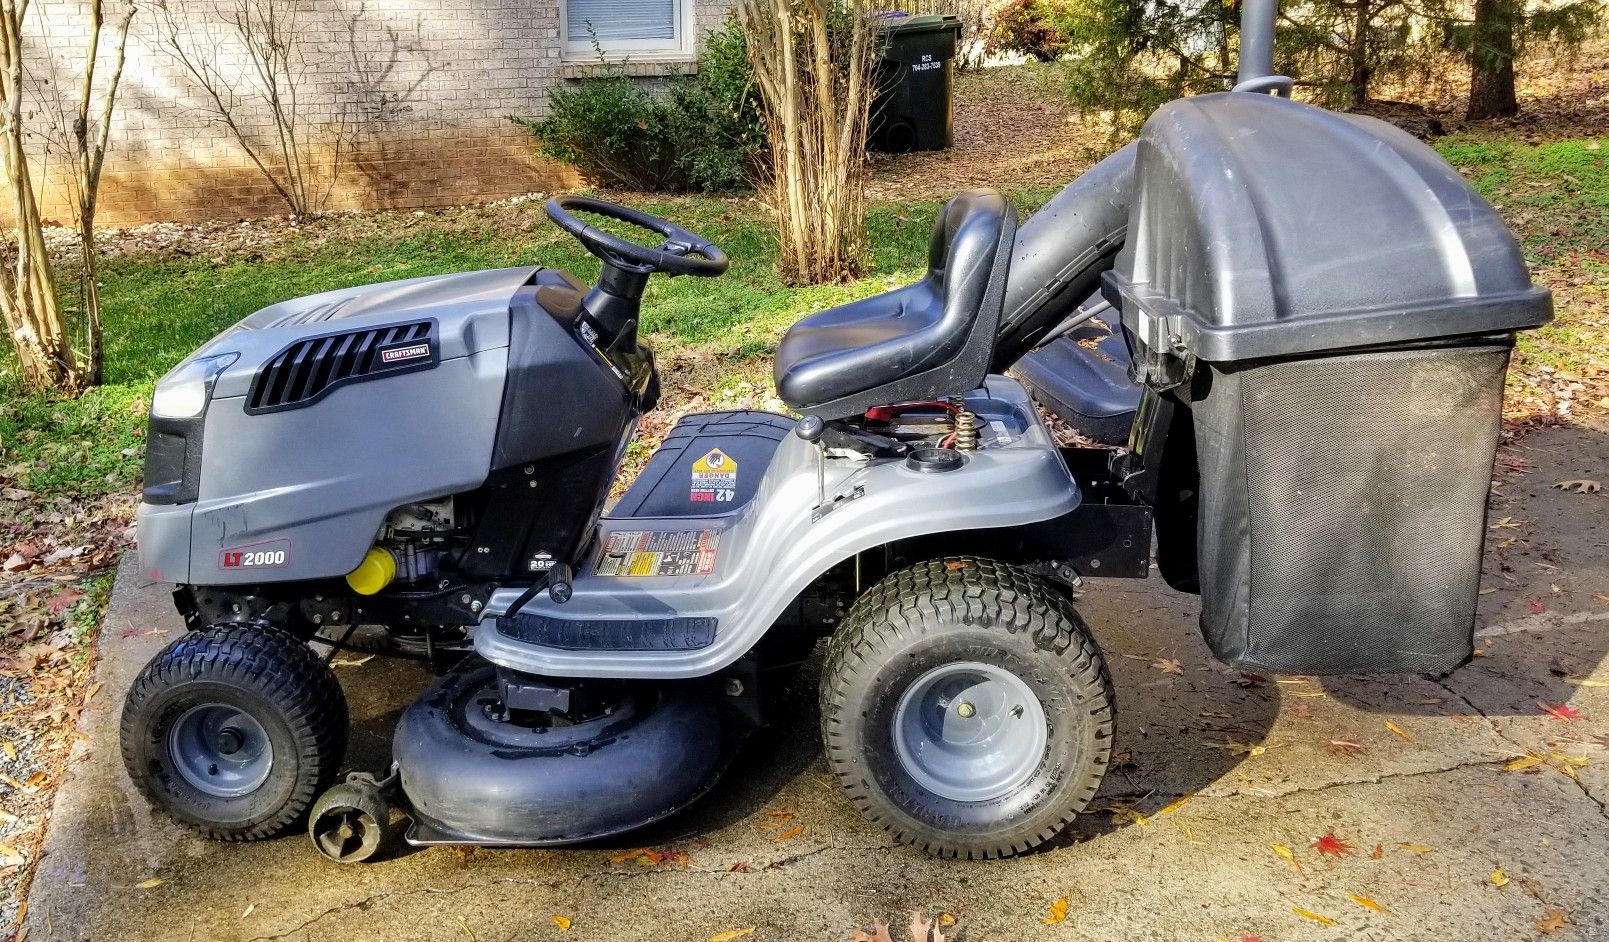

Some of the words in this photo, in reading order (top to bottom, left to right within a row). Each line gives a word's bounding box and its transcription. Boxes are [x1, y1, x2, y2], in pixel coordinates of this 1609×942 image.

[385, 347, 426, 360] CRAFTSMAN
[690, 492, 715, 502] INCH
[716, 489, 735, 502] 42
[224, 552, 243, 567] LT
[243, 551, 285, 566] 2000
